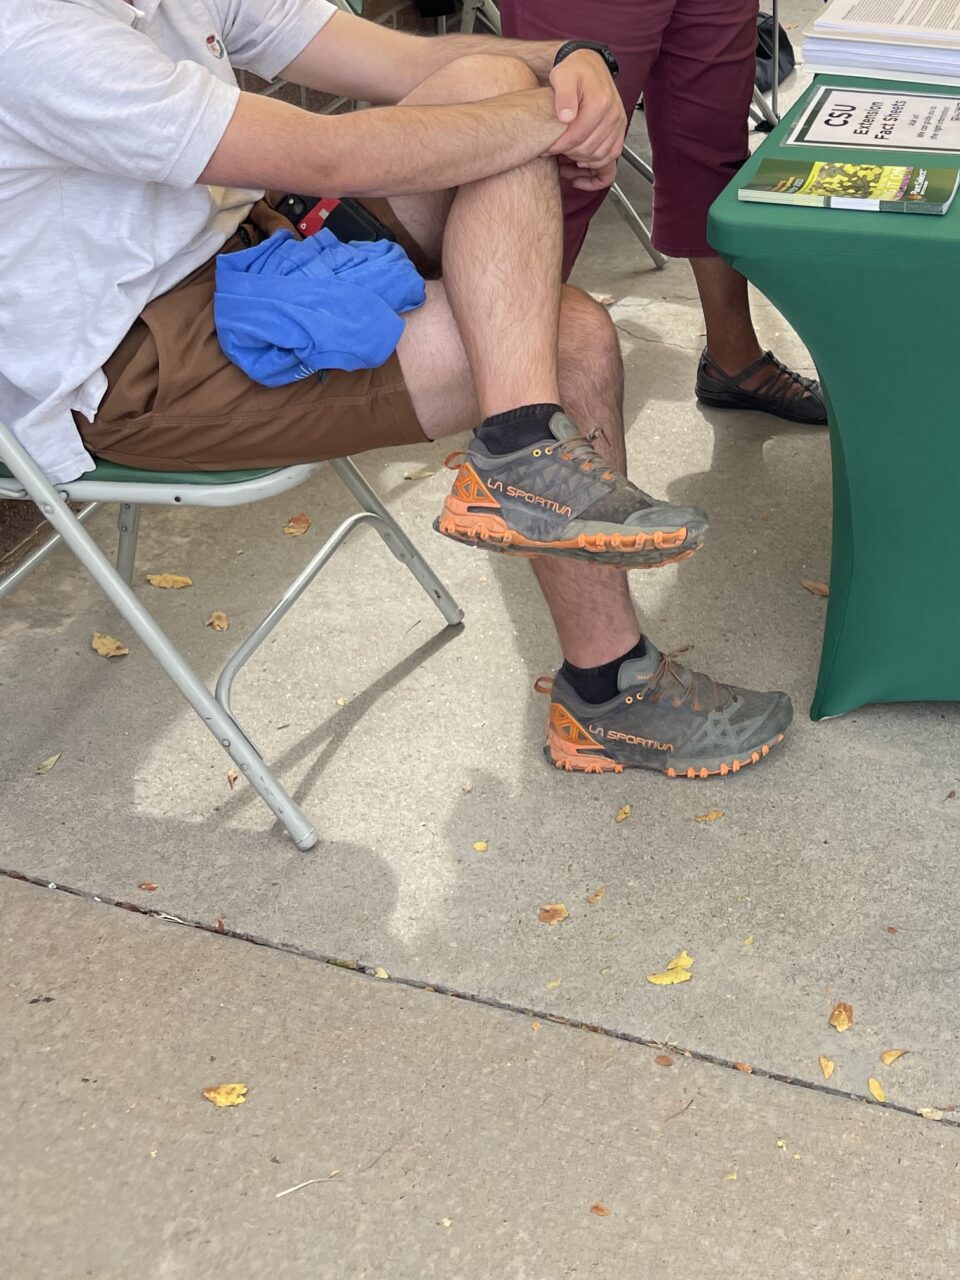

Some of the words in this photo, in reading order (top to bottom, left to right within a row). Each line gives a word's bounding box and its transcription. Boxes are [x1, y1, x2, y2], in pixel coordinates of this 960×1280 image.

[824, 103, 857, 127] CSU
[853, 101, 885, 135] Extension
[874, 122, 895, 140] Fact
[886, 99, 907, 122] Sheets
[487, 478, 503, 492] LA
[506, 485, 572, 518] SPORTIVA
[589, 724, 604, 737] LA
[607, 730, 673, 752] SPORTIVA
